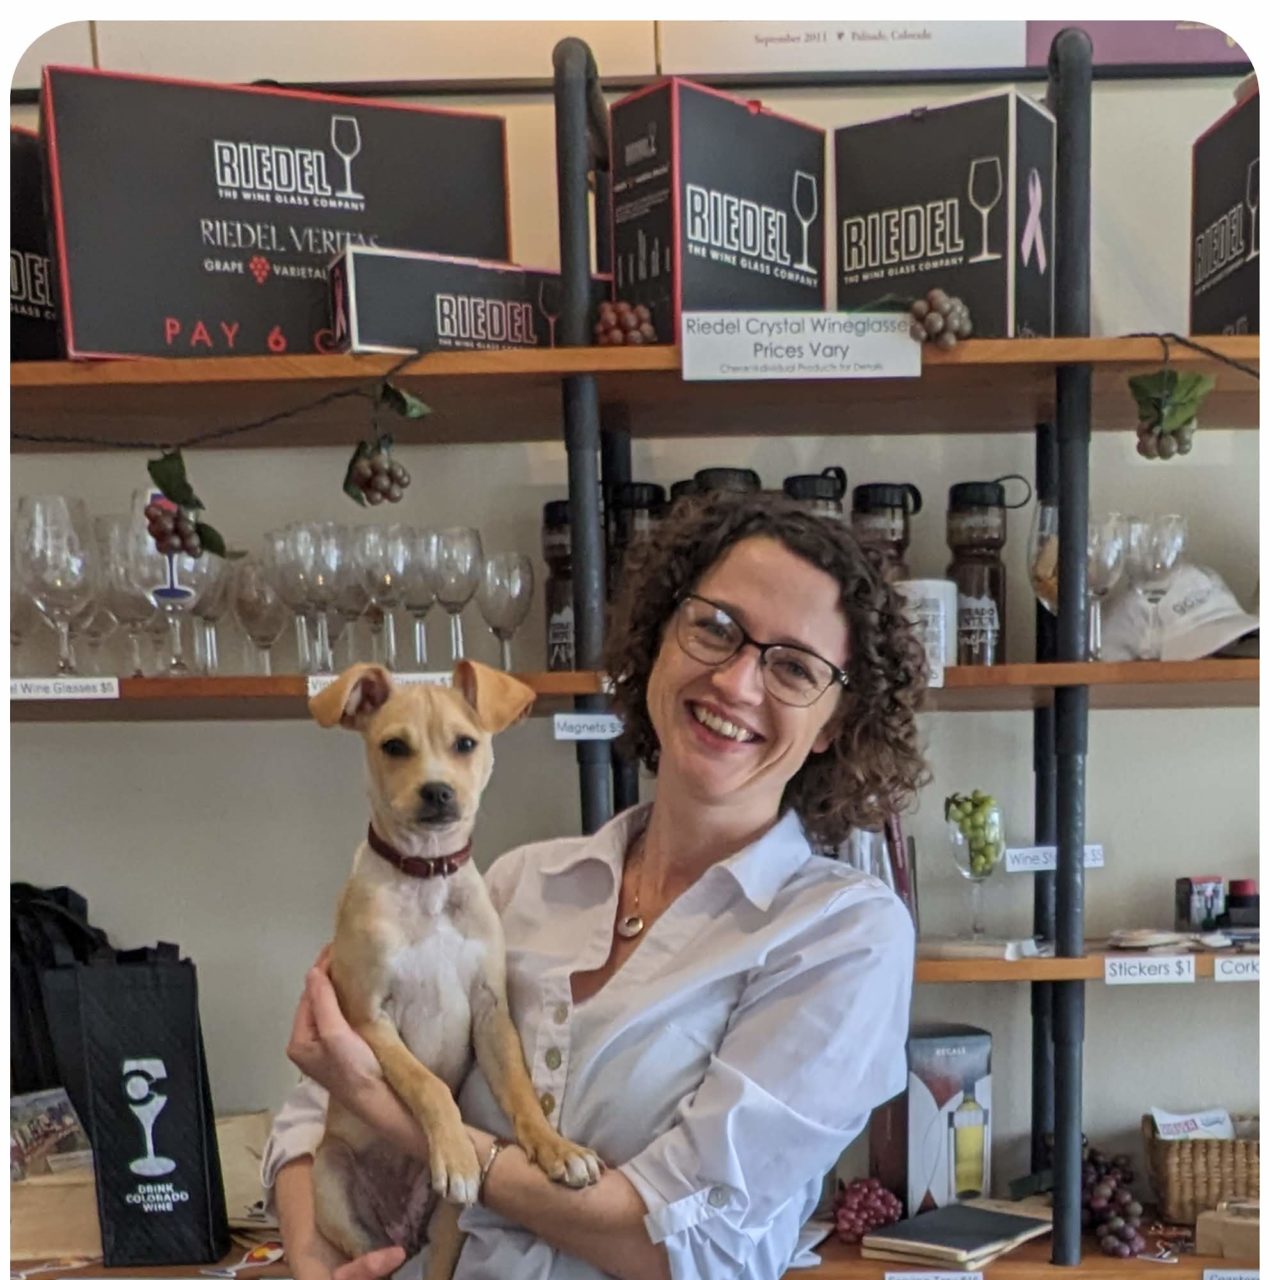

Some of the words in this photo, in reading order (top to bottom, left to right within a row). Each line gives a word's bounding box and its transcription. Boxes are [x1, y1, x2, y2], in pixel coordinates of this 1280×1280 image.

[214, 139, 332, 197] RIEDEL
[218, 188, 238, 200] THE
[241, 190, 271, 203] WINE
[274, 194, 310, 207] GLASS
[313, 198, 366, 212] COMPANY
[200, 219, 286, 252] RIEDEL
[686, 183, 791, 267] RIEDEL
[843, 198, 965, 273] RIEDEL
[204, 258, 245, 274] GRAPE
[688, 243, 707, 256] THE
[710, 247, 738, 267] WINE
[740, 257, 771, 276] GLASS
[773, 266, 818, 289] COMPANY
[844, 275, 860, 285] THE
[862, 269, 885, 281] WINE
[888, 264, 917, 277] GLASS
[919, 256, 964, 271] COMPANY
[436, 292, 538, 345] RIEDEL
[686, 317, 740, 335] Riedel
[746, 317, 805, 338] Crystal
[164, 317, 240, 349] PAY
[267, 324, 287, 352] 6
[753, 341, 804, 359] Prices
[809, 341, 851, 362] Vary
[557, 721, 606, 735] Magnets
[1009, 852, 1040, 866] Wine
[1109, 961, 1170, 978] Stickers
[1175, 959, 1192, 977] $1
[126, 1191, 190, 1204] COLORADO
[137, 1183, 175, 1194] DRINK
[142, 1202, 174, 1213] WINE
